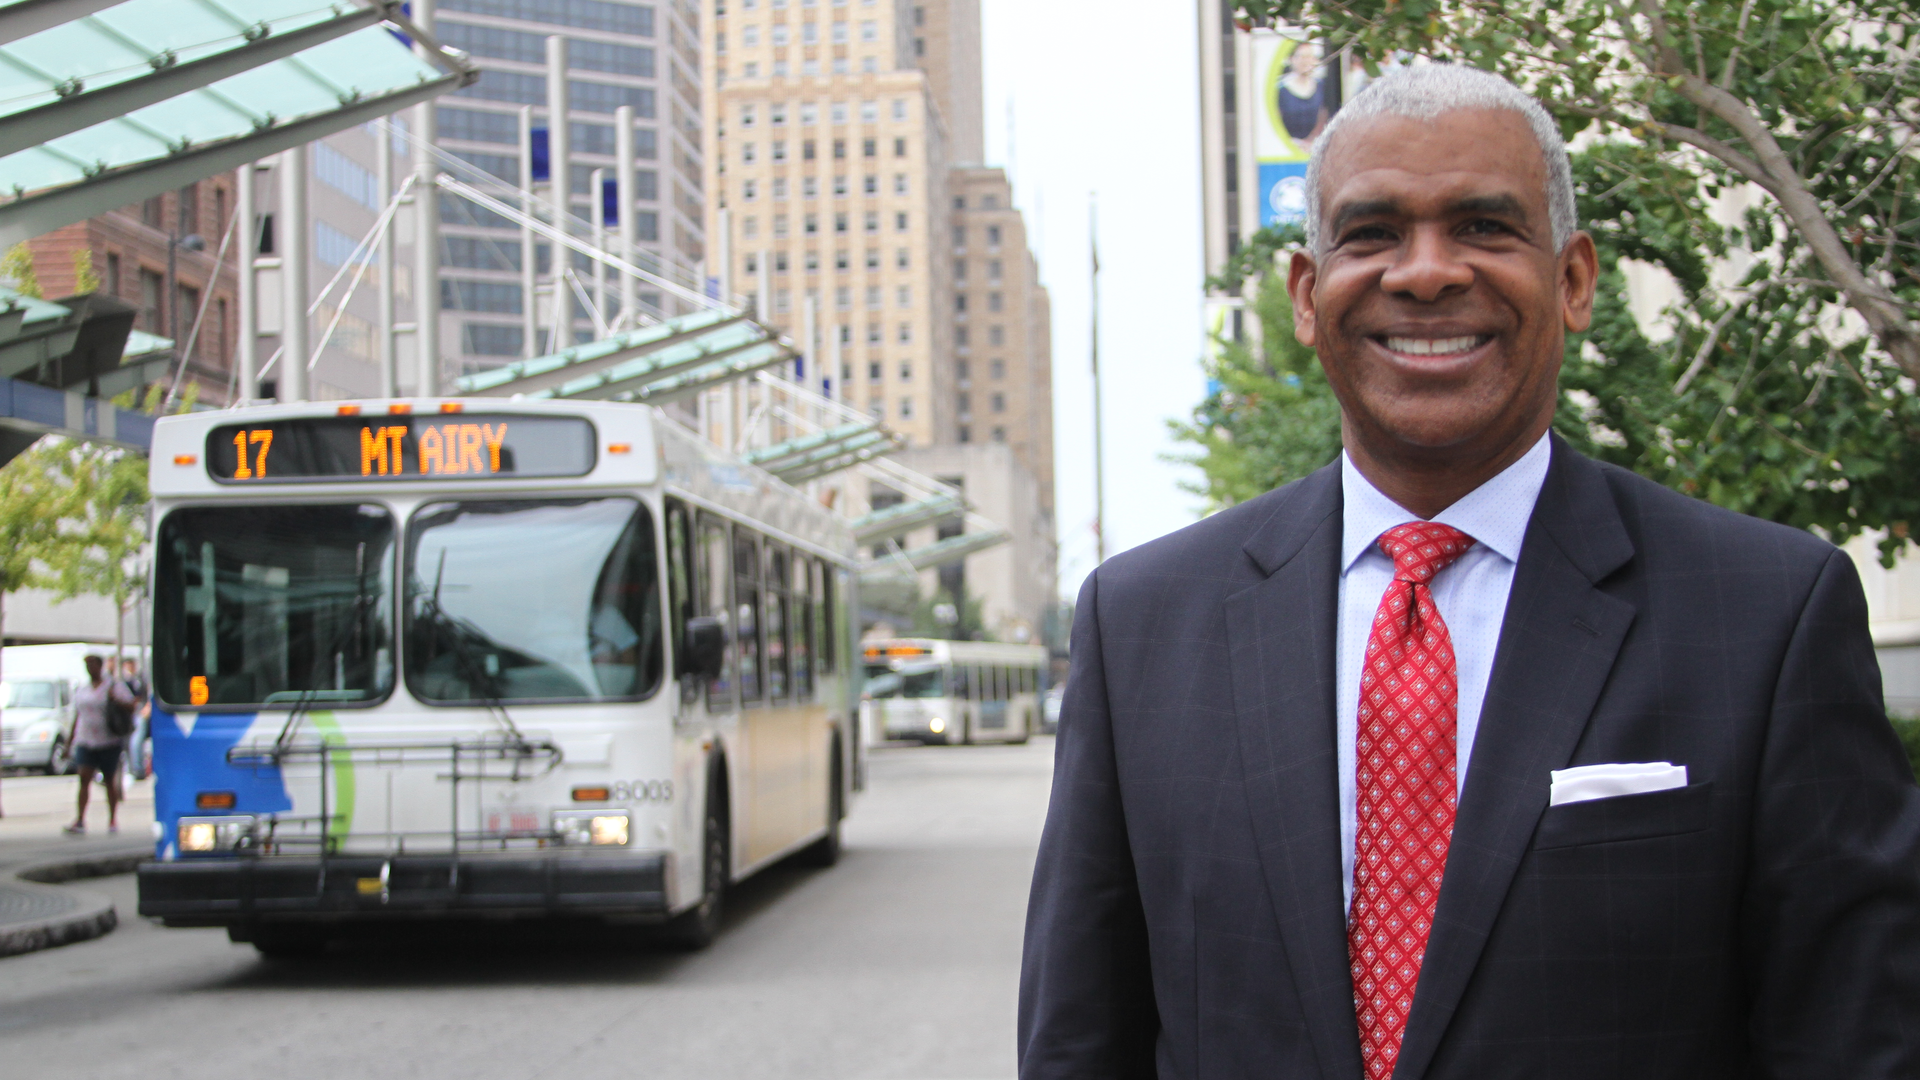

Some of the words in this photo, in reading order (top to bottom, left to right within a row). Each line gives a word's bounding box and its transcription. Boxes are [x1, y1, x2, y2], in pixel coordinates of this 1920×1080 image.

[233, 430, 273, 480] 17
[360, 426, 408, 476] MT
[418, 423, 507, 475] AIRY
[614, 779, 674, 805] 8003
